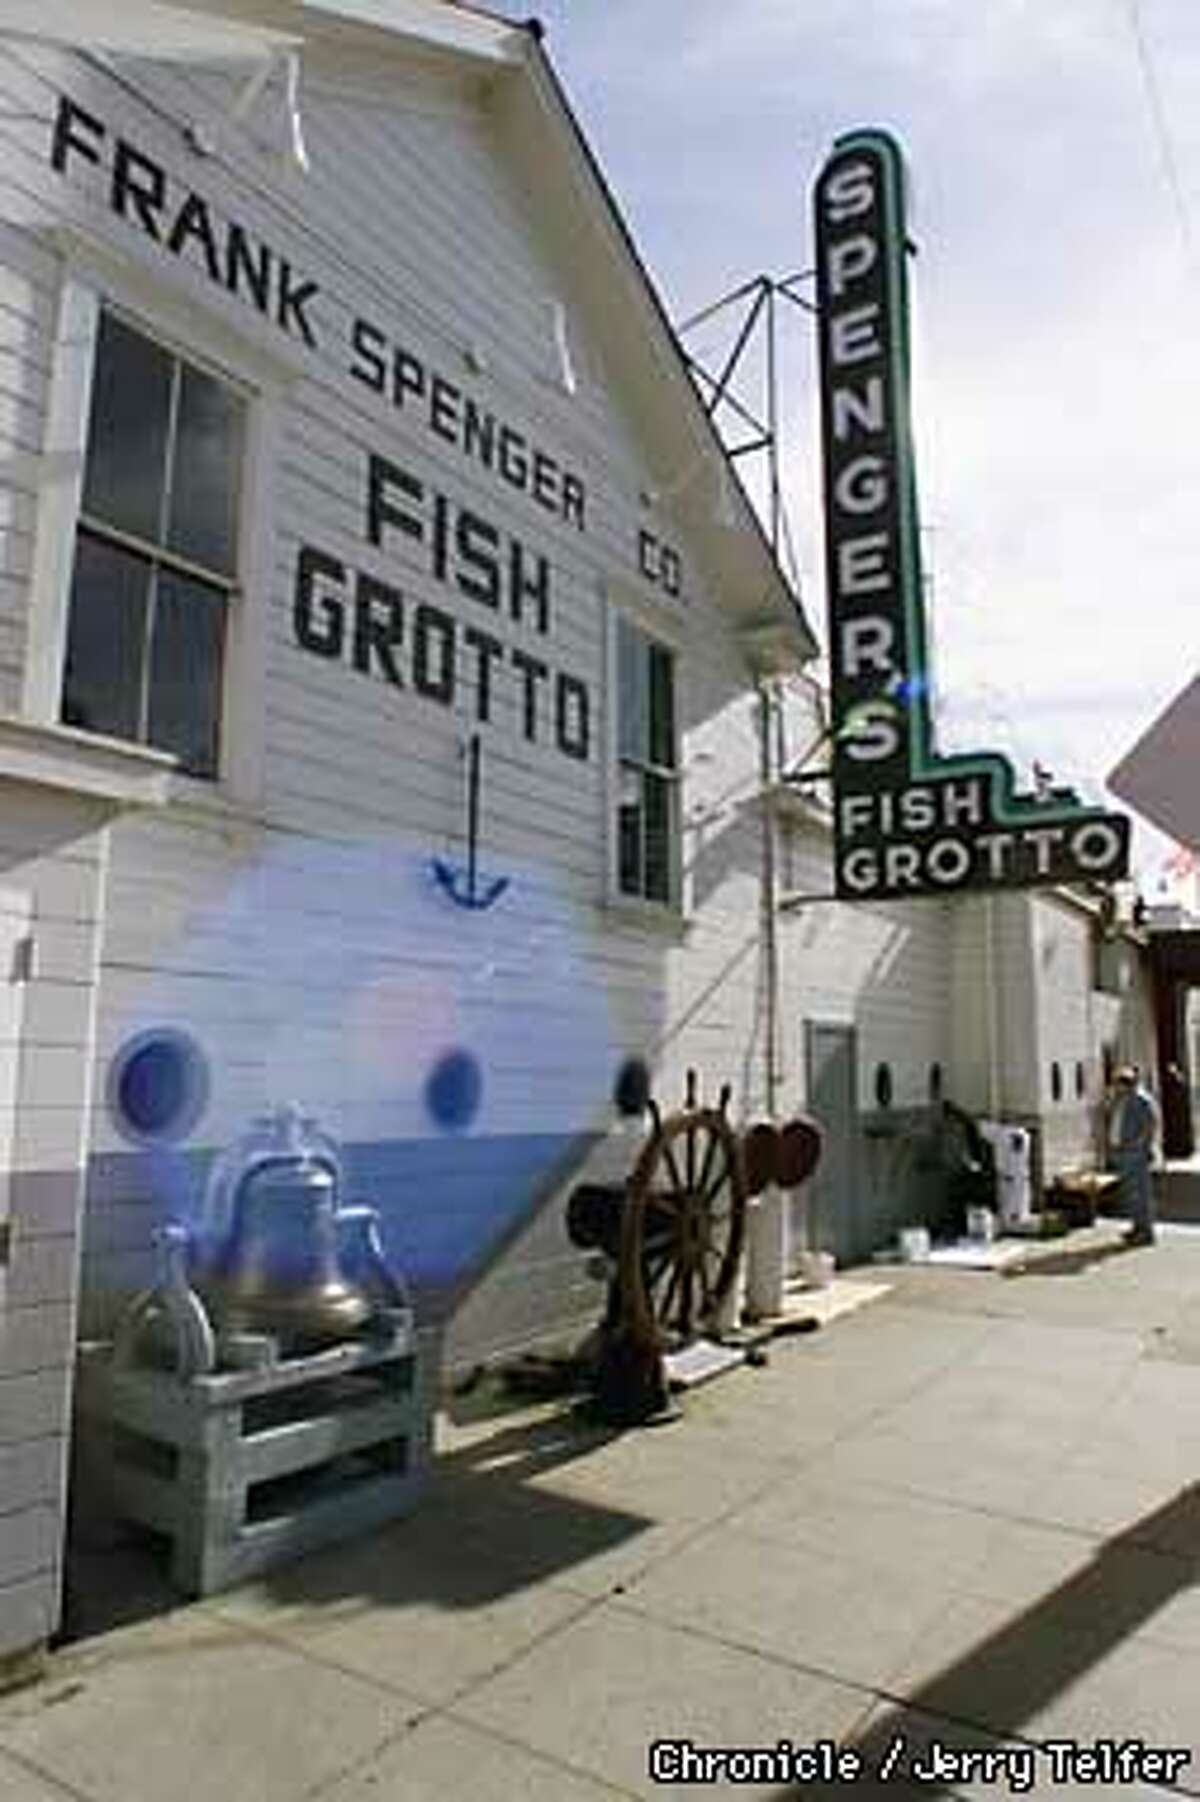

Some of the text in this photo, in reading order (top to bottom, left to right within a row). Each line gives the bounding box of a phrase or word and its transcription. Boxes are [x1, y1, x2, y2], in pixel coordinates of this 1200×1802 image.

[51, 97, 319, 348] FRANK
[349, 318, 586, 531] SPENGER
[365, 453, 550, 635] FISH
[293, 545, 590, 761] GROTTO
[841, 781, 982, 837] FISH
[843, 824, 1119, 892] GROTTO
